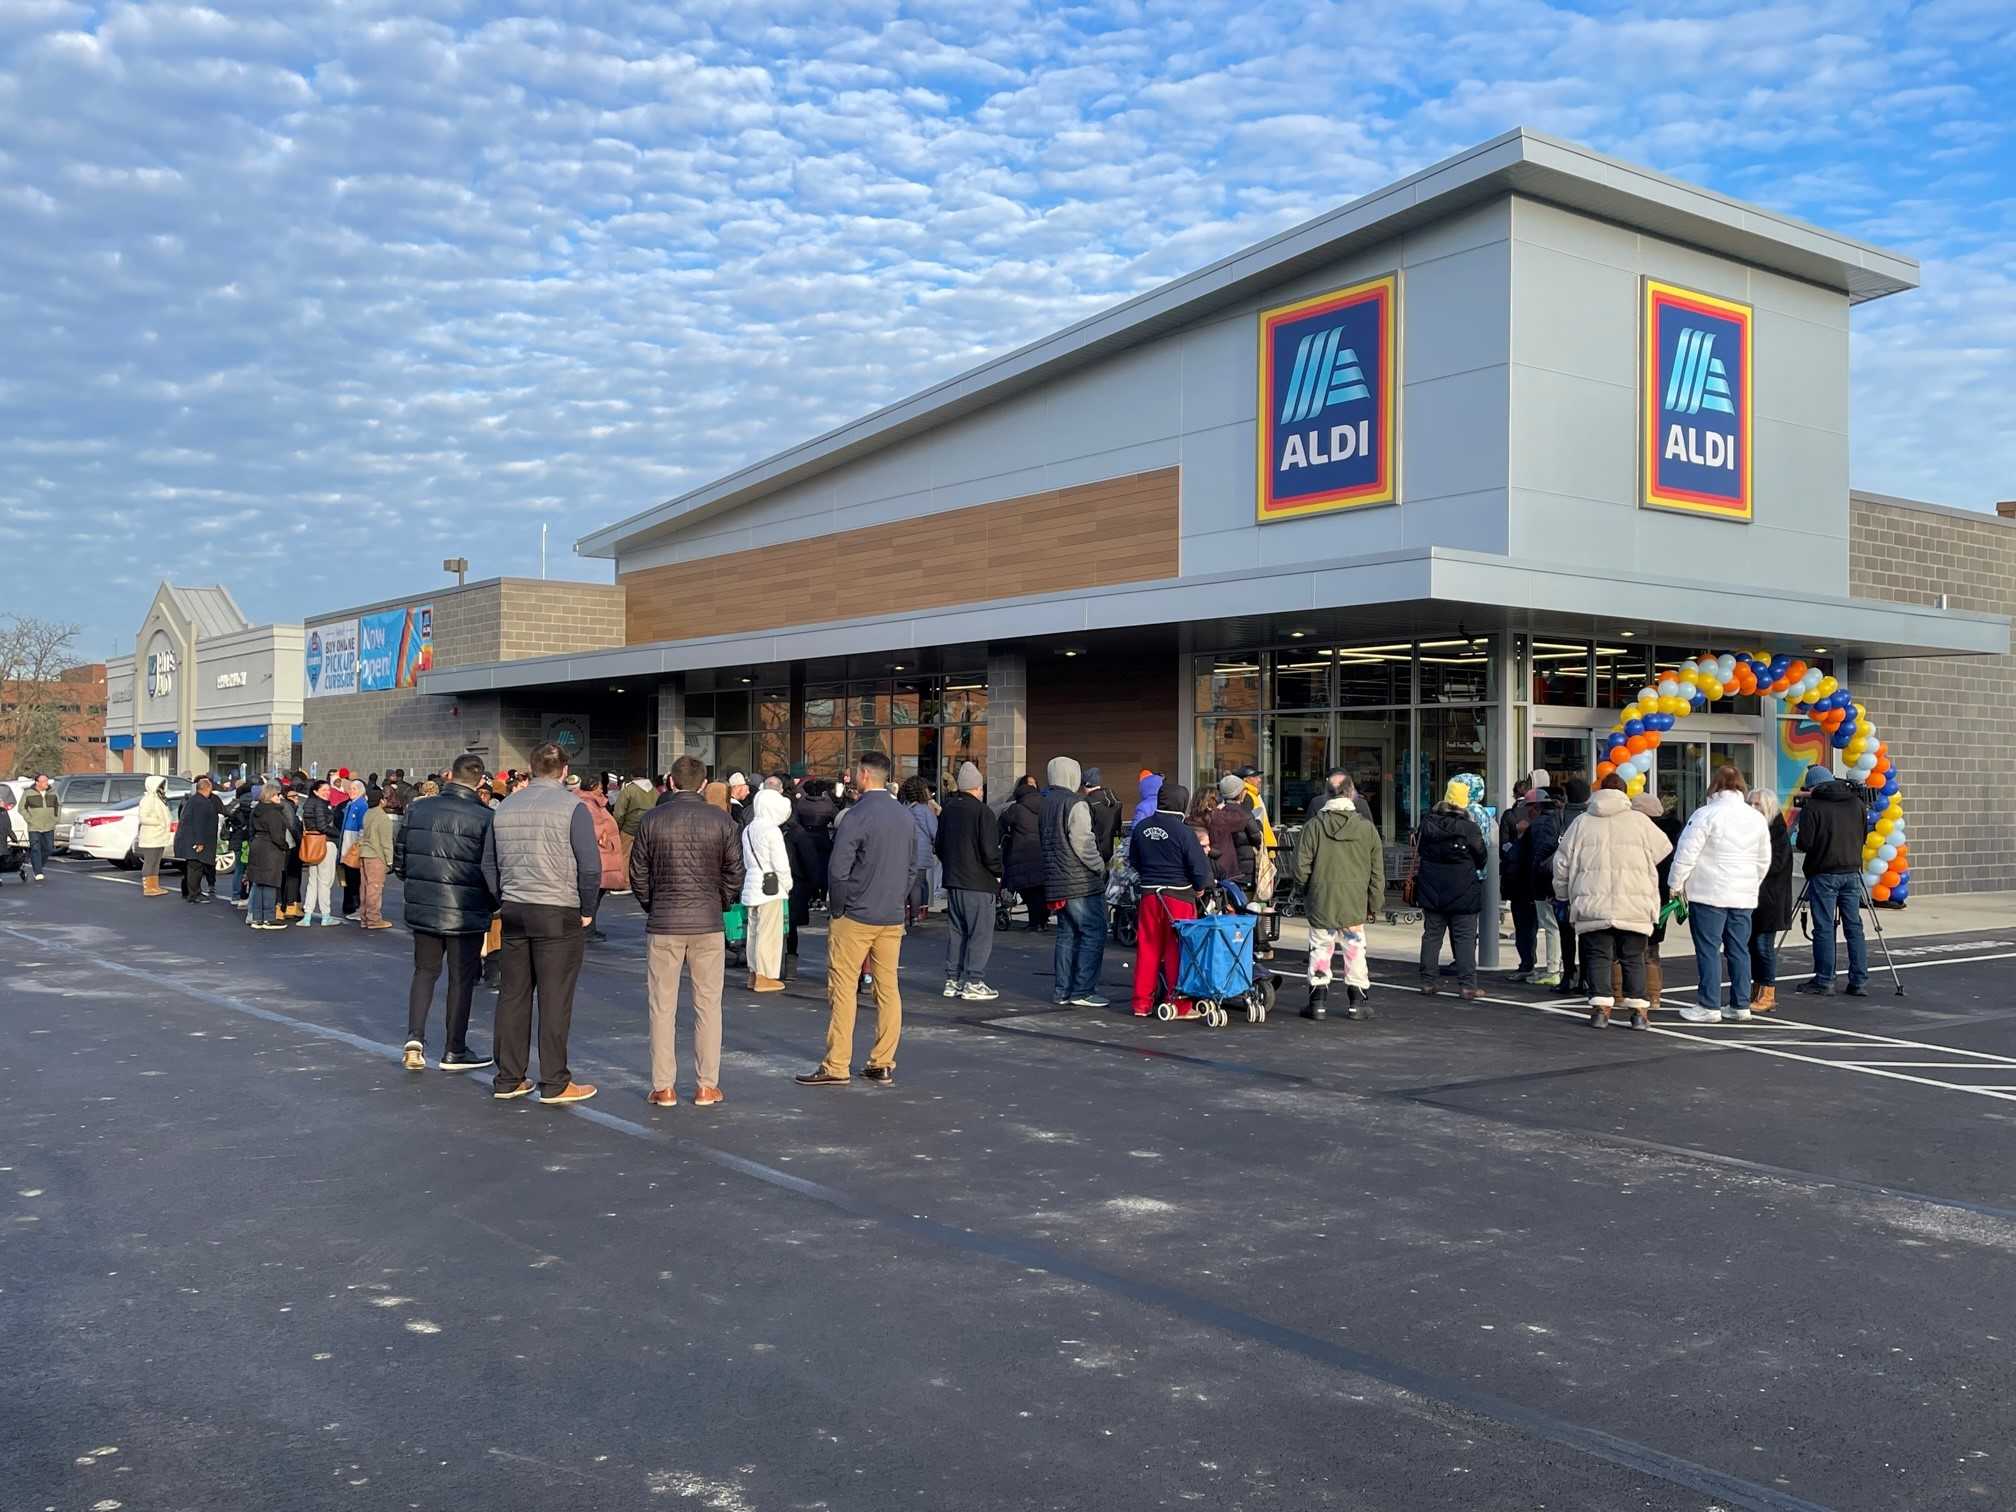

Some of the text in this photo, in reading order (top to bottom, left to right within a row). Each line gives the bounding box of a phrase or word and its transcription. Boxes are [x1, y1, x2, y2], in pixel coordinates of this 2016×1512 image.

[1280, 420, 1369, 471] ALDI
[1664, 424, 1735, 470] ALDI
[363, 627, 384, 649] Now
[325, 652, 342, 672] PICK
[344, 651, 355, 670] UP
